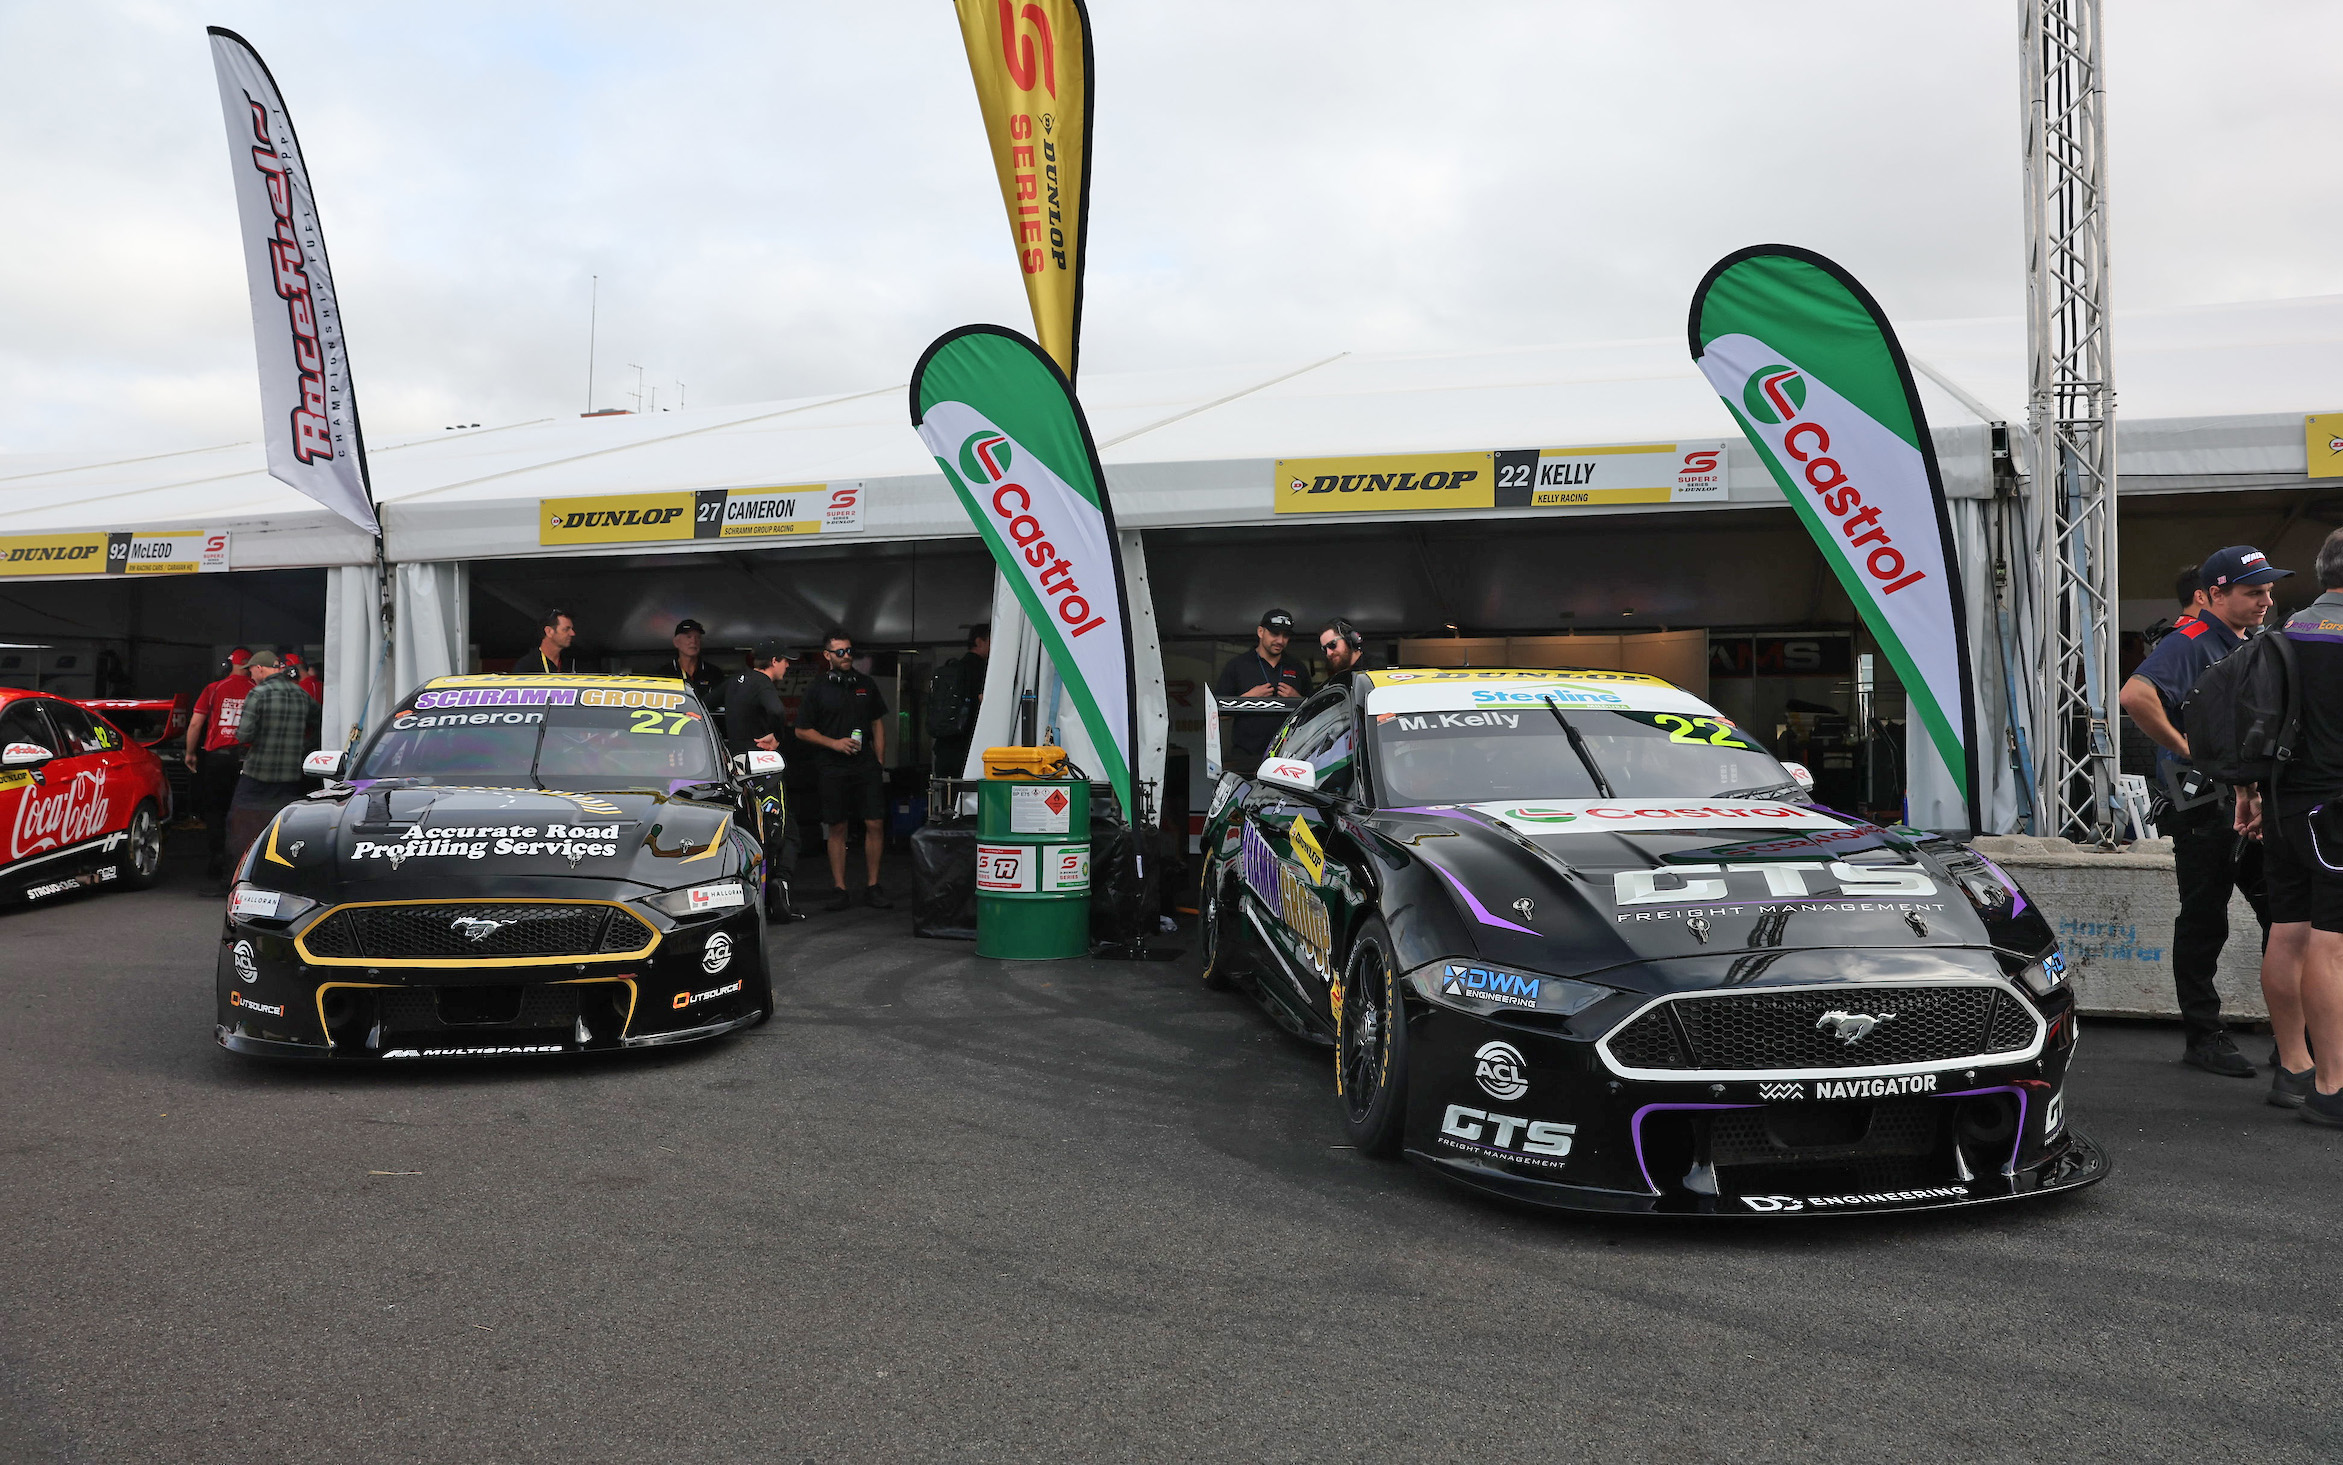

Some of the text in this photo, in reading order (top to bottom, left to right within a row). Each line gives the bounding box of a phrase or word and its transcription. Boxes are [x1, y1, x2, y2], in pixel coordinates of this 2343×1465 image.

[1010, 113, 1045, 275] SERIES
[1043, 138, 1067, 271] DUNLOP
[304, 211, 317, 263] FUEL
[317, 282, 345, 457] CHAMPIONSHIP
[1307, 469, 1478, 494] DUNLOP
[1498, 464, 1531, 488] 22
[1540, 462, 1596, 486] KELLY
[727, 498, 796, 521] CAMERON
[1537, 493, 1589, 504] KELLY RACING
[1784, 422, 1927, 596] Castrol
[562, 507, 684, 529] DUNLOP
[696, 502, 721, 523] 27
[724, 524, 794, 536] SCHRAMM GROUP RACING
[7, 545, 99, 562] DUNLOP
[109, 543, 127, 560] 92
[130, 542, 173, 559] McLEOD
[992, 483, 1107, 638] Castrol
[1431, 672, 1650, 682] DUNLOP
[414, 688, 686, 710] SCHRAMM GROUP
[1471, 689, 1623, 703] Steeline
[392, 710, 544, 731] Cameron
[629, 710, 692, 736] 27
[1654, 714, 1749, 749] 22
[11, 767, 109, 860] Coca-Cola
[1585, 805, 1807, 820] Castrol
[400, 824, 620, 840] Accurate Road
[350, 838, 617, 861] Profiling Services
[1296, 831, 1322, 868] DUNLOP
[1613, 861, 1938, 906] GTS
[1617, 904, 1946, 923] FREIGHT MANAGEMENT
[702, 944, 732, 962] ACL
[1467, 968, 1540, 999] DWM
[1465, 989, 1537, 1008] ENGINEERING
[422, 1045, 563, 1056] MULTISPARES
[1475, 1060, 1529, 1085] ACL
[1815, 1073, 1939, 1101] NAVIGATOR
[1440, 1103, 1577, 1157] GTS
[1437, 1137, 1566, 1169] FREIGHT MANAGEMENT
[1807, 1185, 1969, 1206] ENGINEERING
